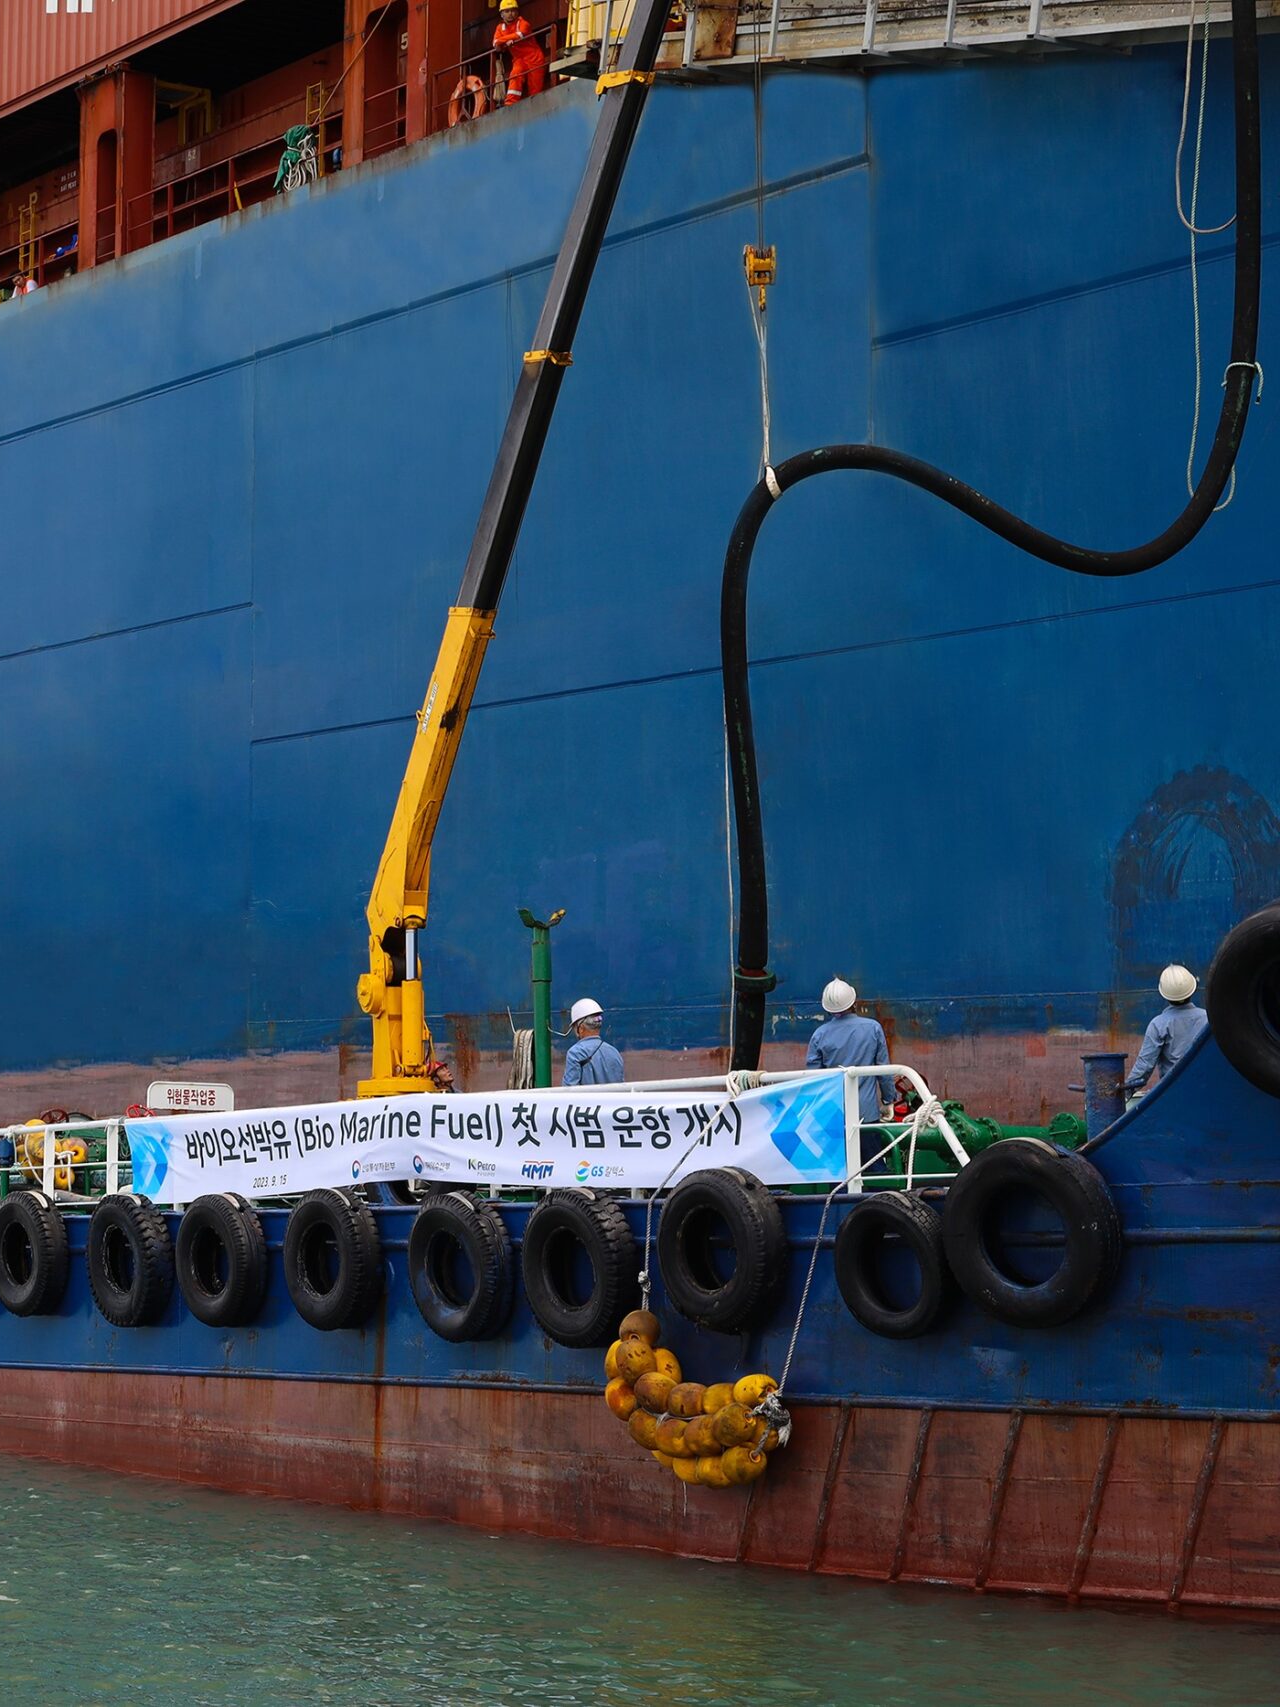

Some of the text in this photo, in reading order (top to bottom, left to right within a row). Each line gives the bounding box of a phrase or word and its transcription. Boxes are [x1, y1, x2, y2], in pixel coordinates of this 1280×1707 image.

[166, 1087, 216, 1106] 위험물작업중
[184, 1101, 742, 1168] 바이오선박유 (Bio Marine Fuel) 첫 시범 운항 개시
[521, 1161, 554, 1180] HMM
[591, 1165, 603, 1177] GS
[253, 1177, 270, 1188] 2023.
[279, 1174, 287, 1185] 15
